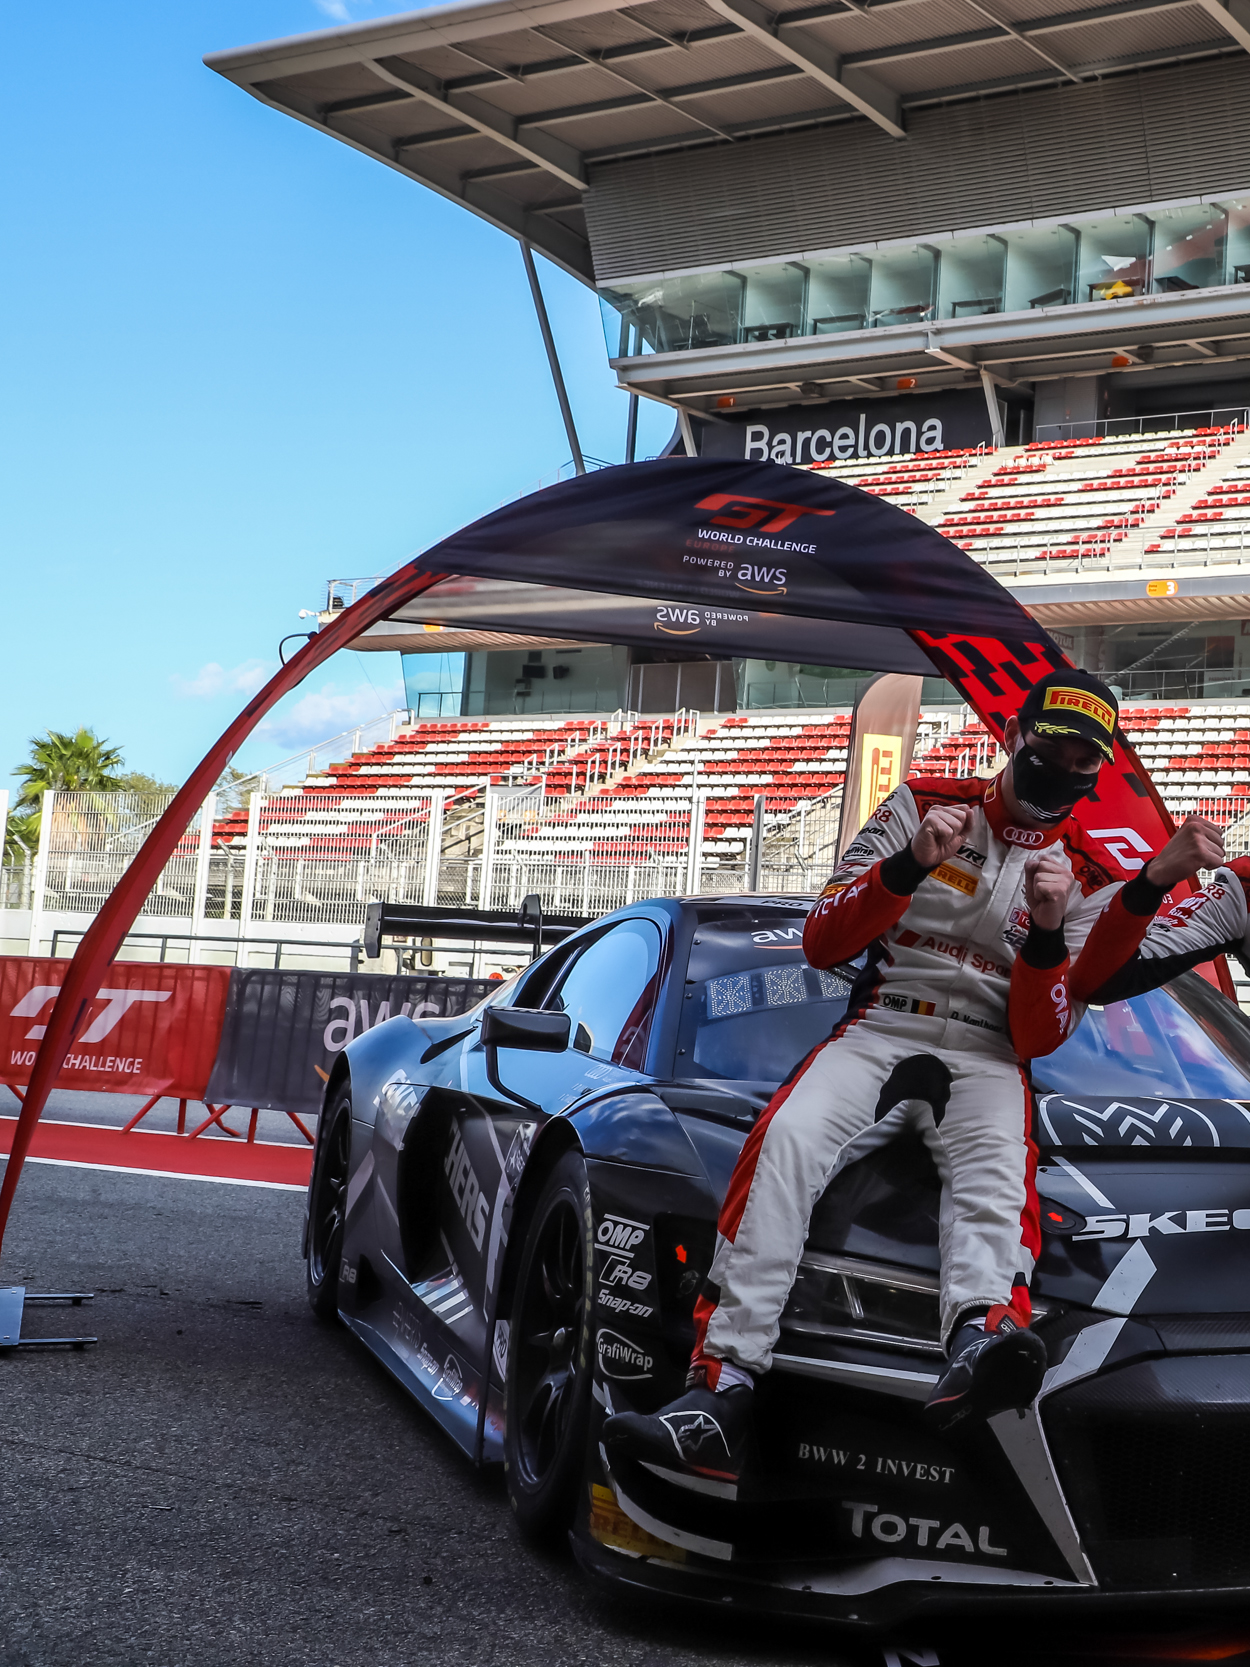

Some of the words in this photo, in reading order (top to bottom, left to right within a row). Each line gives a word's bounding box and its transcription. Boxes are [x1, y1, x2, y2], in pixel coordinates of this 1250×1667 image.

[909, 379, 916, 388] 2
[744, 413, 945, 464] Barcelona
[686, 538, 736, 553] EUROPE
[698, 528, 744, 544] WORLD
[746, 536, 817, 554] CHALLENGE
[683, 555, 734, 569] POWERED
[718, 569, 732, 578] BY
[737, 563, 787, 585] aws
[1166, 582, 1175, 595] 3
[1049, 691, 1112, 726] PIRELLI
[1202, 884, 1226, 900] R8
[921, 936, 969, 961] Audi
[970, 954, 1012, 978] Spor
[882, 996, 908, 1010] OMP
[62, 1054, 142, 1074] CHALLENGE
[597, 1220, 645, 1250] OMP
[609, 1264, 652, 1291] R8
[597, 1289, 653, 1318] Snap-on
[597, 1337, 653, 1371] GrafiWrap
[798, 1443, 850, 1466] BWW
[857, 1454, 866, 1470] 2
[876, 1457, 955, 1484] INVEST
[842, 1501, 1008, 1556] TOTAL
